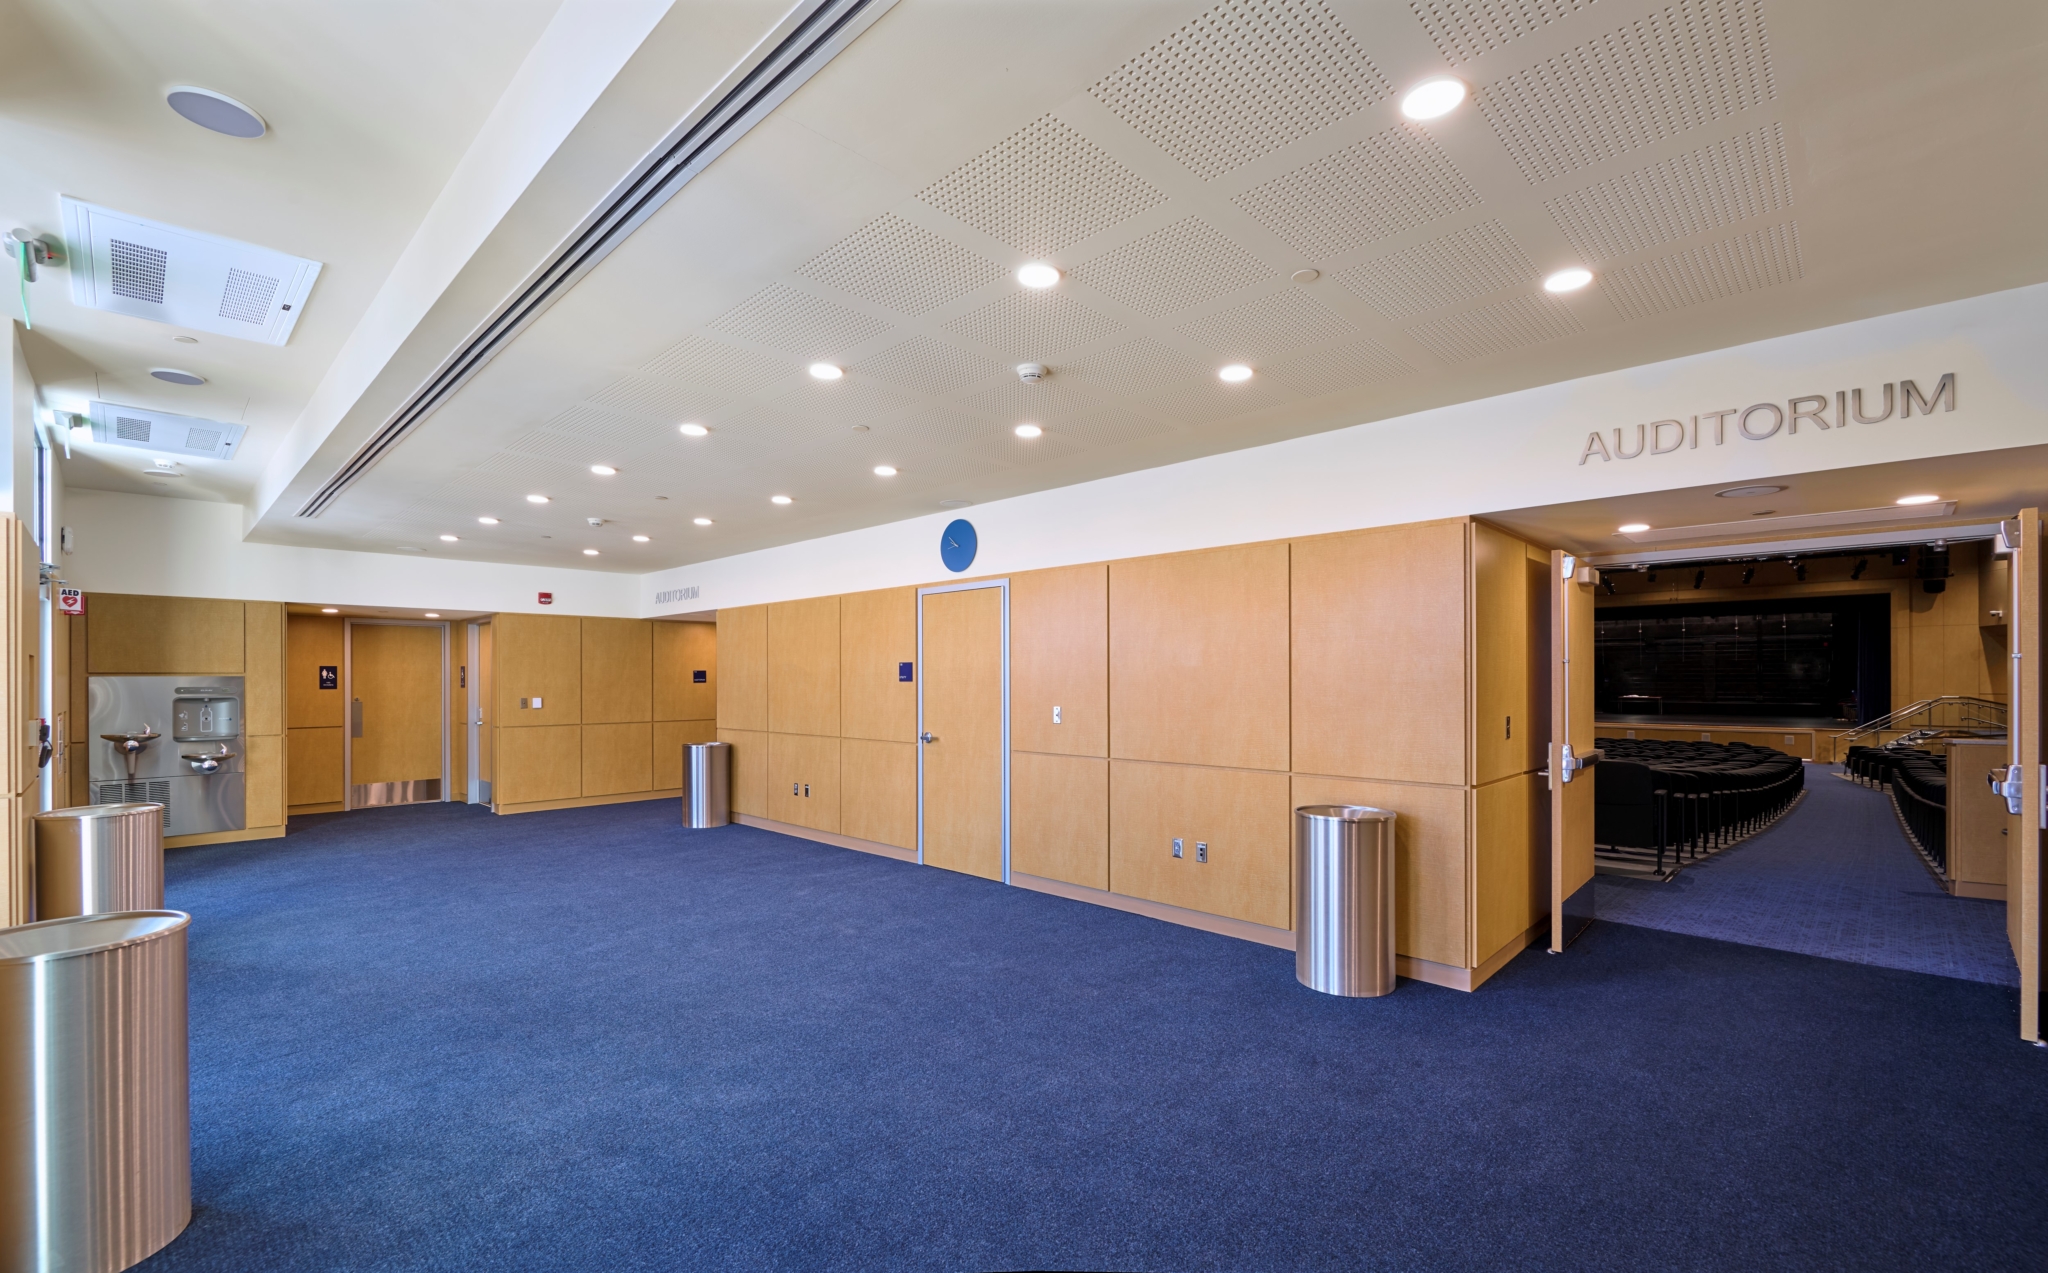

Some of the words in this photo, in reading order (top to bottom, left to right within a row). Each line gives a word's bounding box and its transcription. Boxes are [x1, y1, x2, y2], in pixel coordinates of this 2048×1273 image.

[1578, 373, 1955, 466] AUDITORIUM
[61, 589, 80, 597] AED
[655, 586, 700, 605] AUDITORIUM
